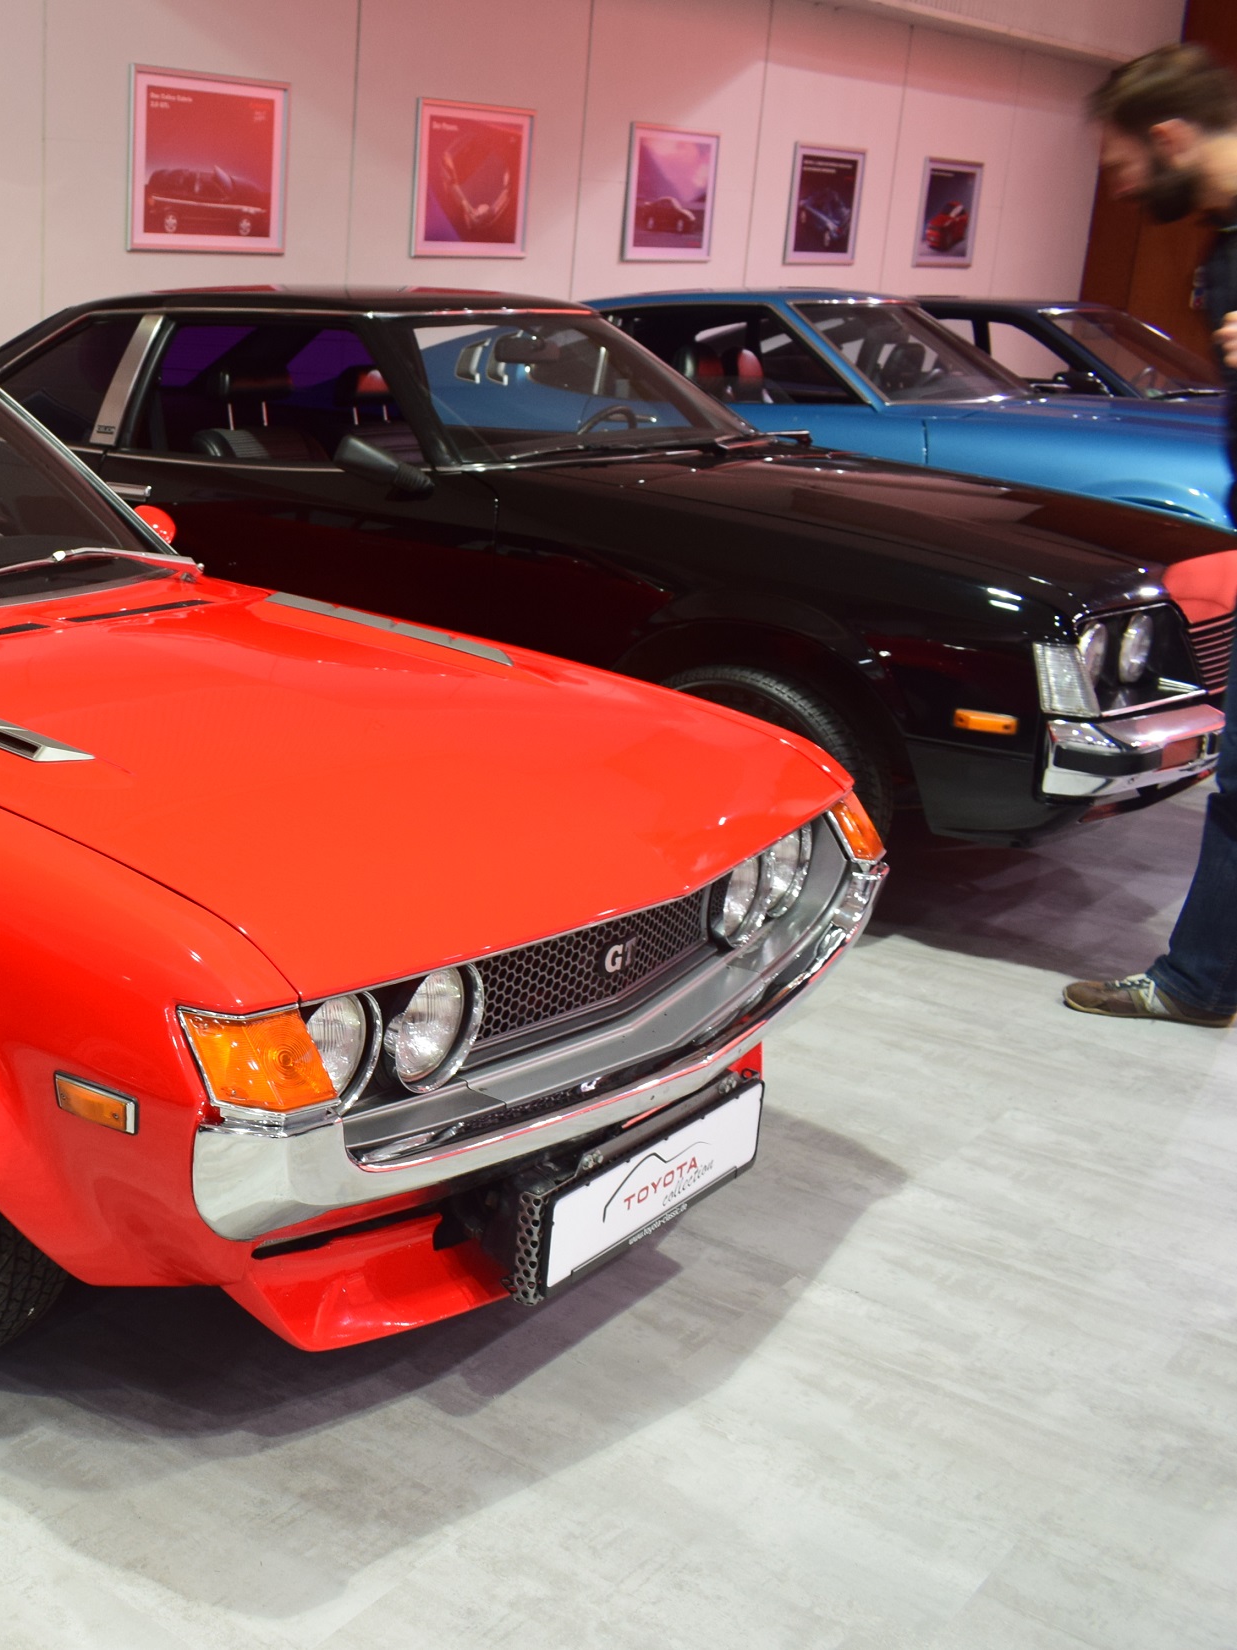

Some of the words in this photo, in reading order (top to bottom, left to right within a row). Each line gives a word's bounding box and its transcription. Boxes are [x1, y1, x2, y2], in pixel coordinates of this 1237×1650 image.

[604, 935, 638, 973] GT
[624, 1157, 698, 1210] TOYOTA
[663, 1160, 714, 1206] collection
